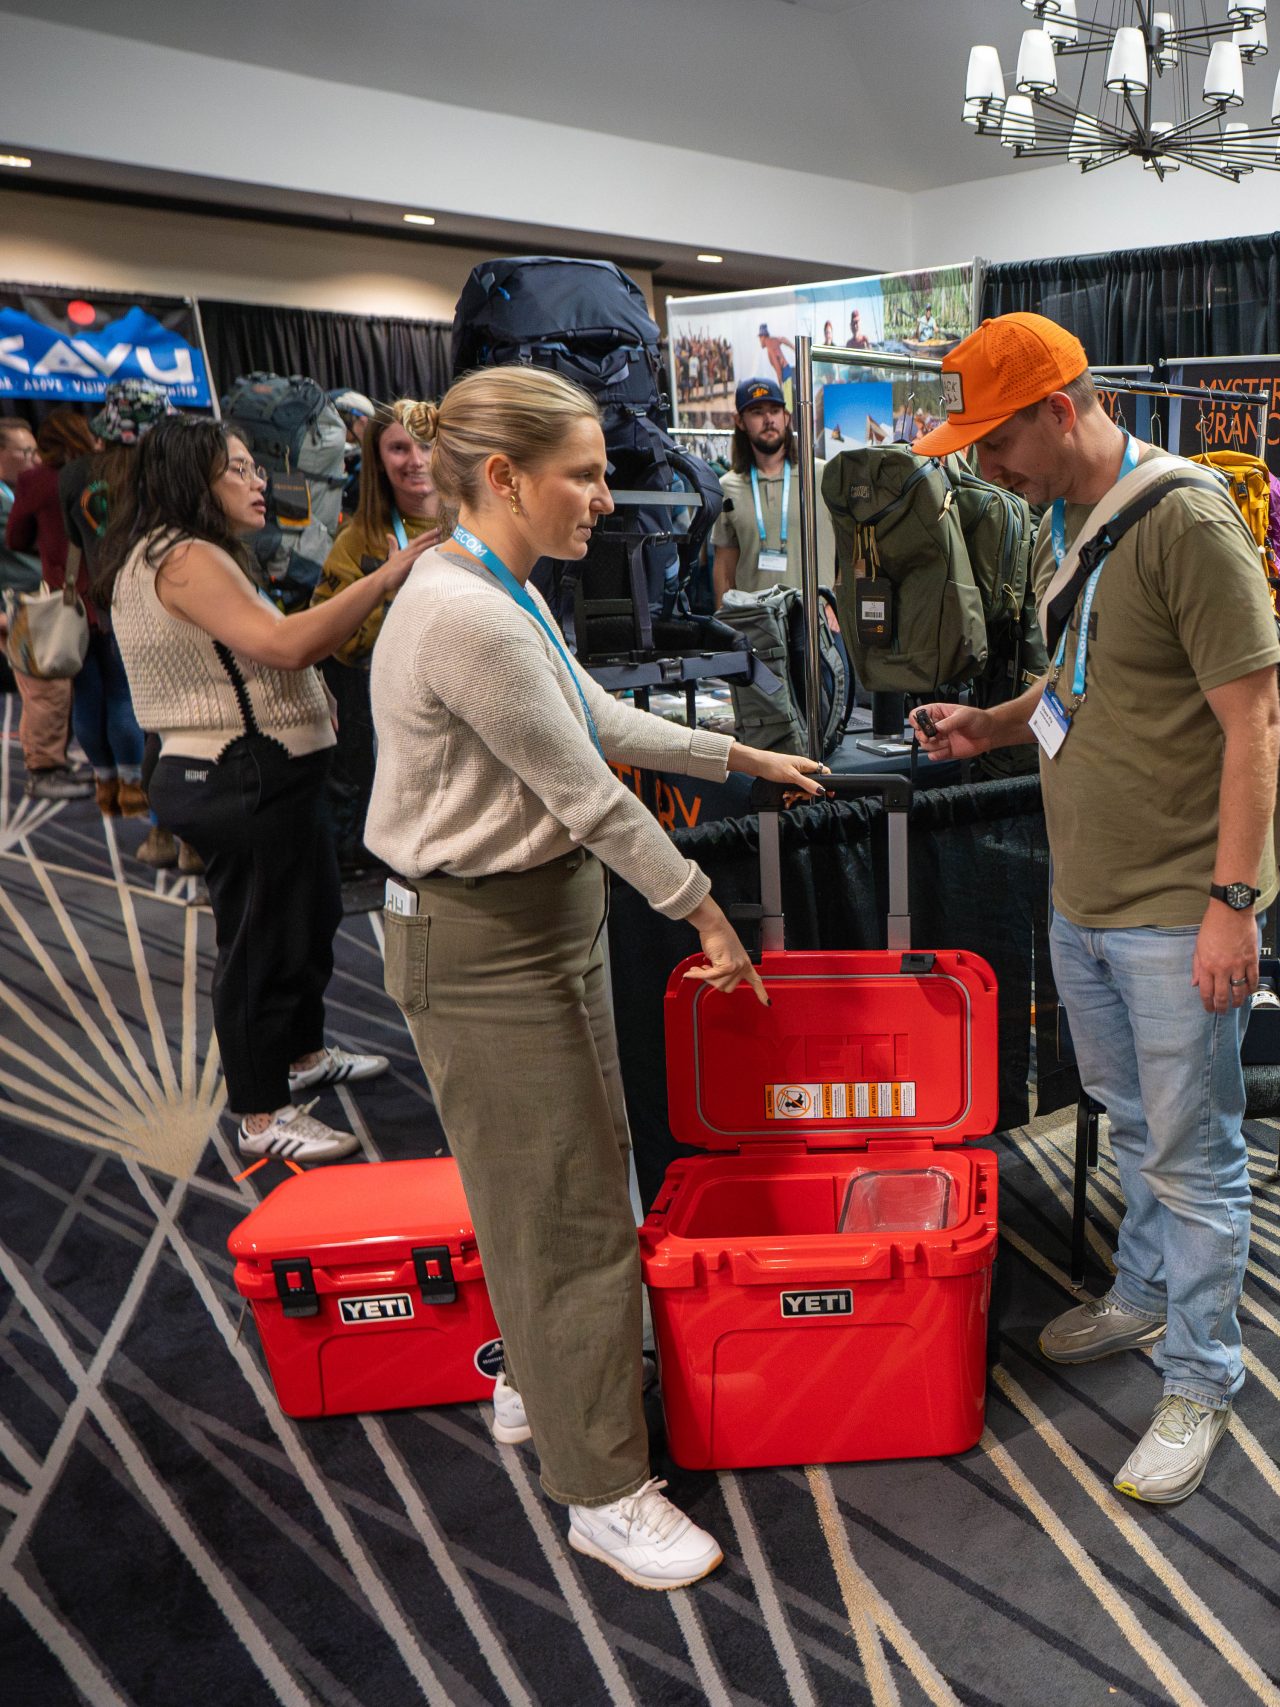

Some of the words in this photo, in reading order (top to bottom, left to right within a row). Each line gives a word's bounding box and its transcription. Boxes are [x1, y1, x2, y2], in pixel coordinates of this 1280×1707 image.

[1261, 947, 1272, 955] TI
[344, 1298, 408, 1320] YETI
[785, 1294, 847, 1313] YETI
